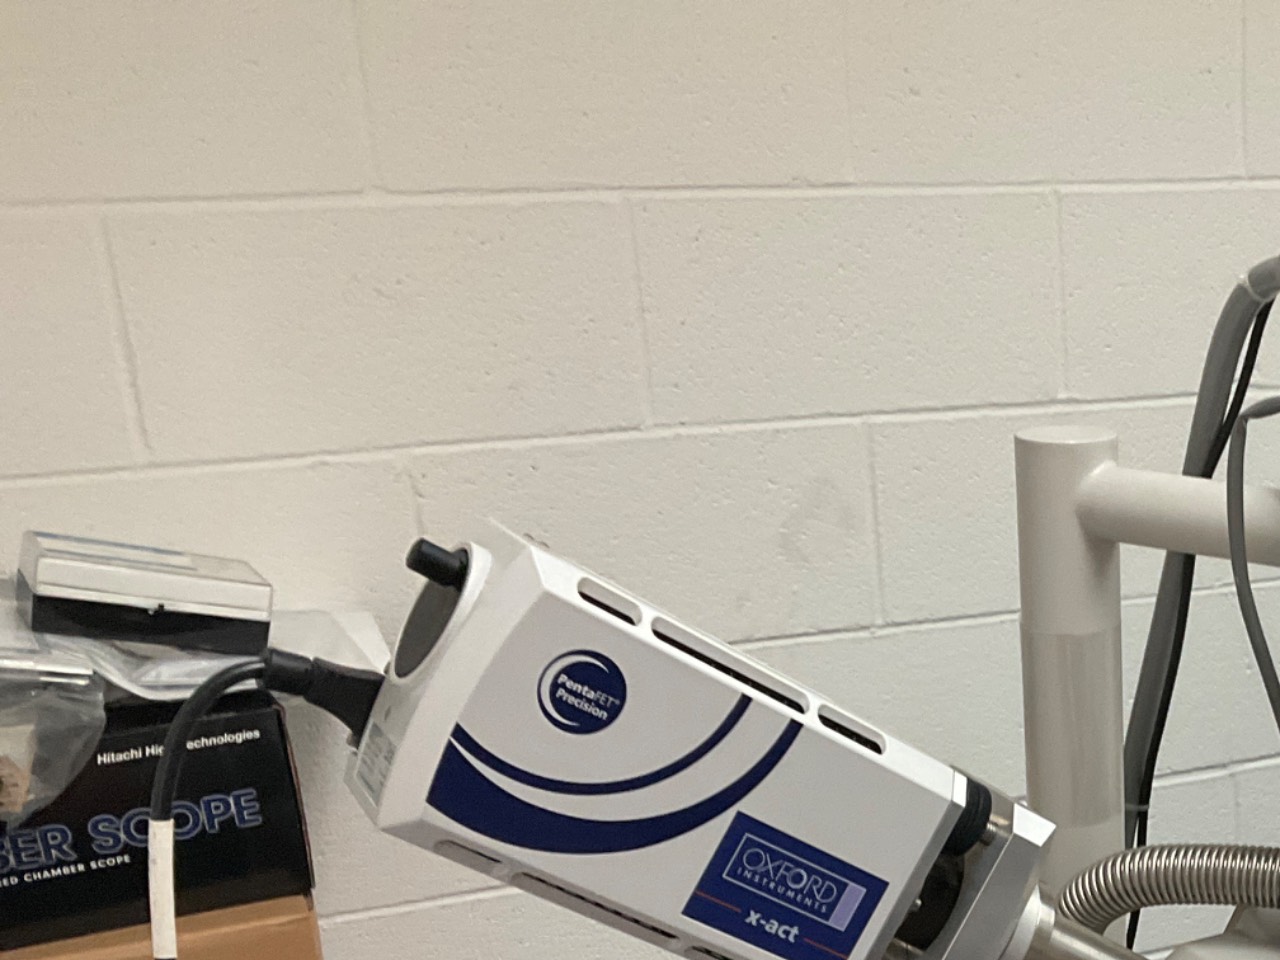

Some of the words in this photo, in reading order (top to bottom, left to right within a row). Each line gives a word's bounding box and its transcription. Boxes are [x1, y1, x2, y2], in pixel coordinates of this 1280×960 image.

[556, 687, 608, 720] Precision
[97, 747, 142, 766] Hitachi
[186, 729, 261, 750] echnologies
[87, 788, 263, 854] SCOPE
[23, 863, 86, 882] CHAMBER
[89, 854, 131, 870] SCOPE
[742, 847, 838, 904] OXFORD
[736, 866, 828, 914] INSTRUMENTS
[745, 909, 800, 944] x-act
